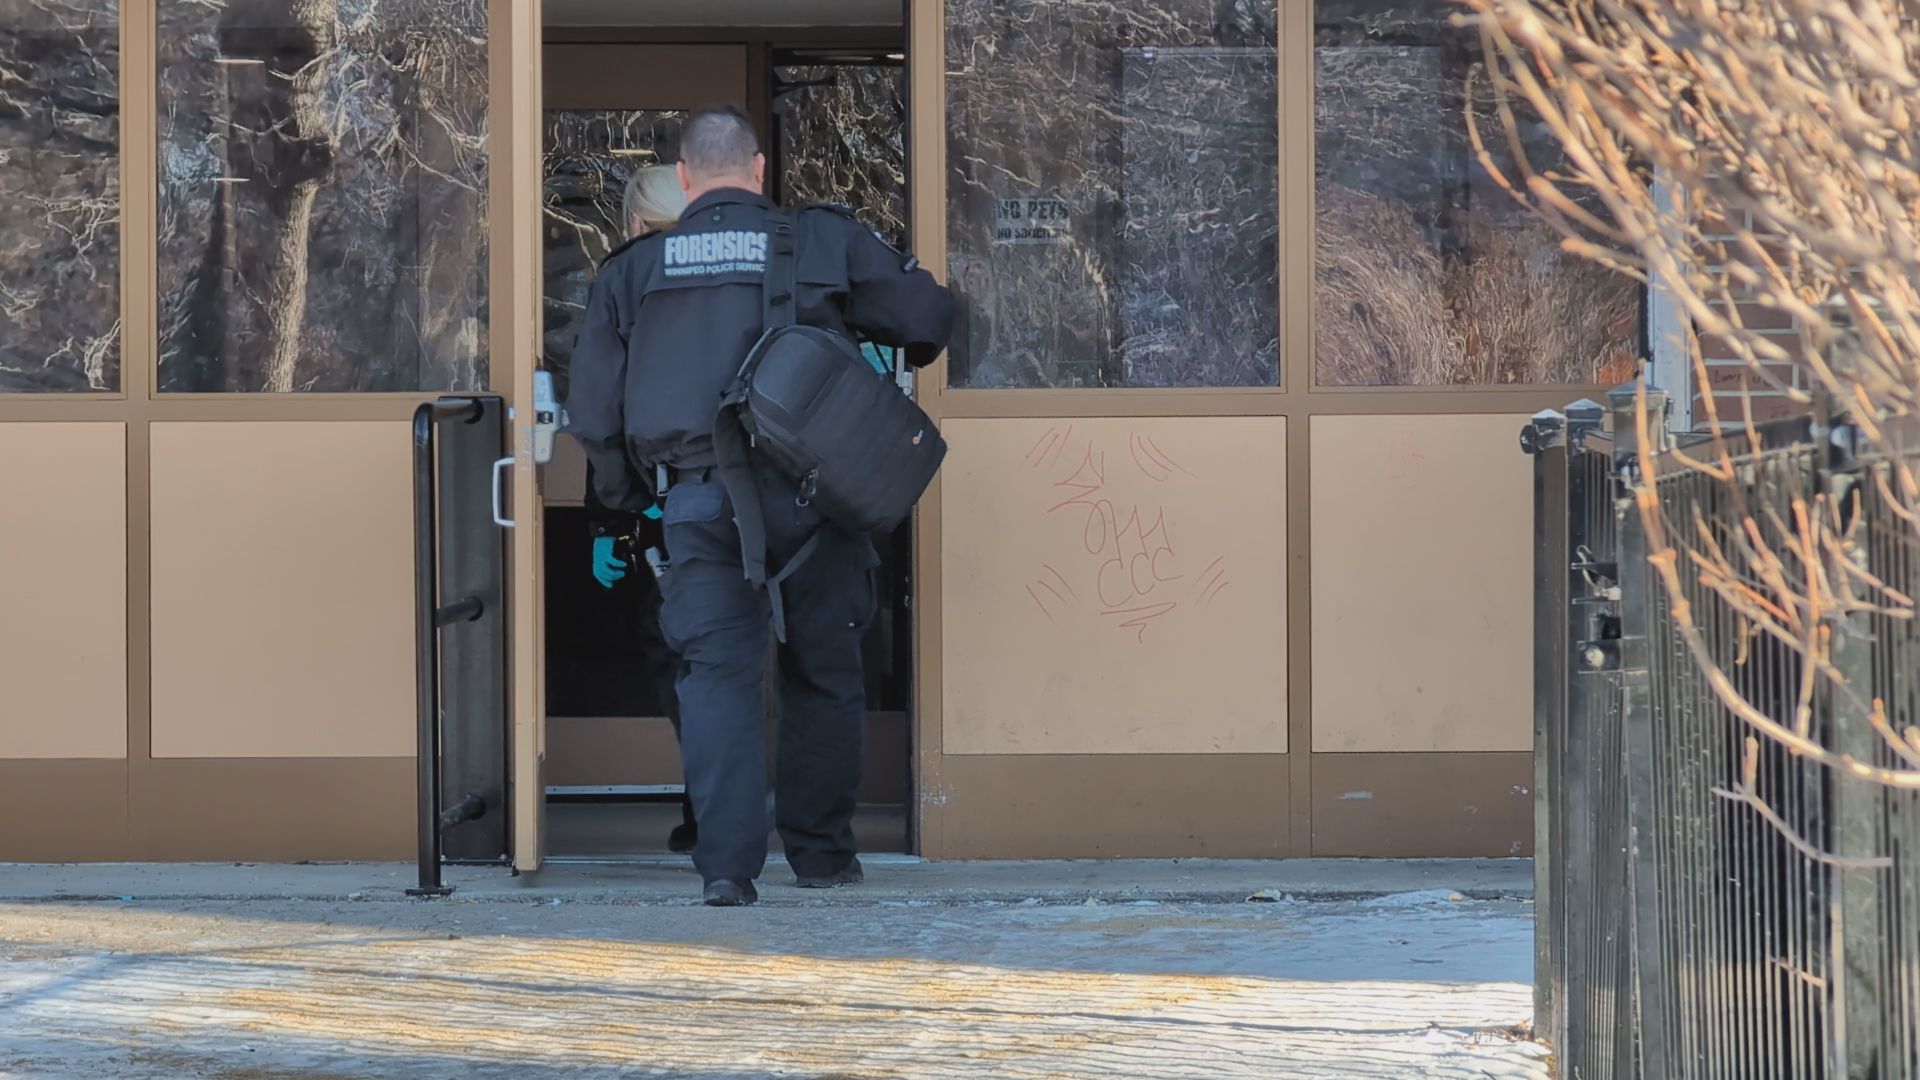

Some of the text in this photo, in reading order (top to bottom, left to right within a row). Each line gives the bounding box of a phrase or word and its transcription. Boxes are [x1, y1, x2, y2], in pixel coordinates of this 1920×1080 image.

[998, 200, 1069, 219] NO PETS
[997, 228, 1011, 239] NO
[664, 231, 768, 264] FORENSICS
[706, 263, 735, 273] POLICE
[735, 262, 766, 272] SERVIC
